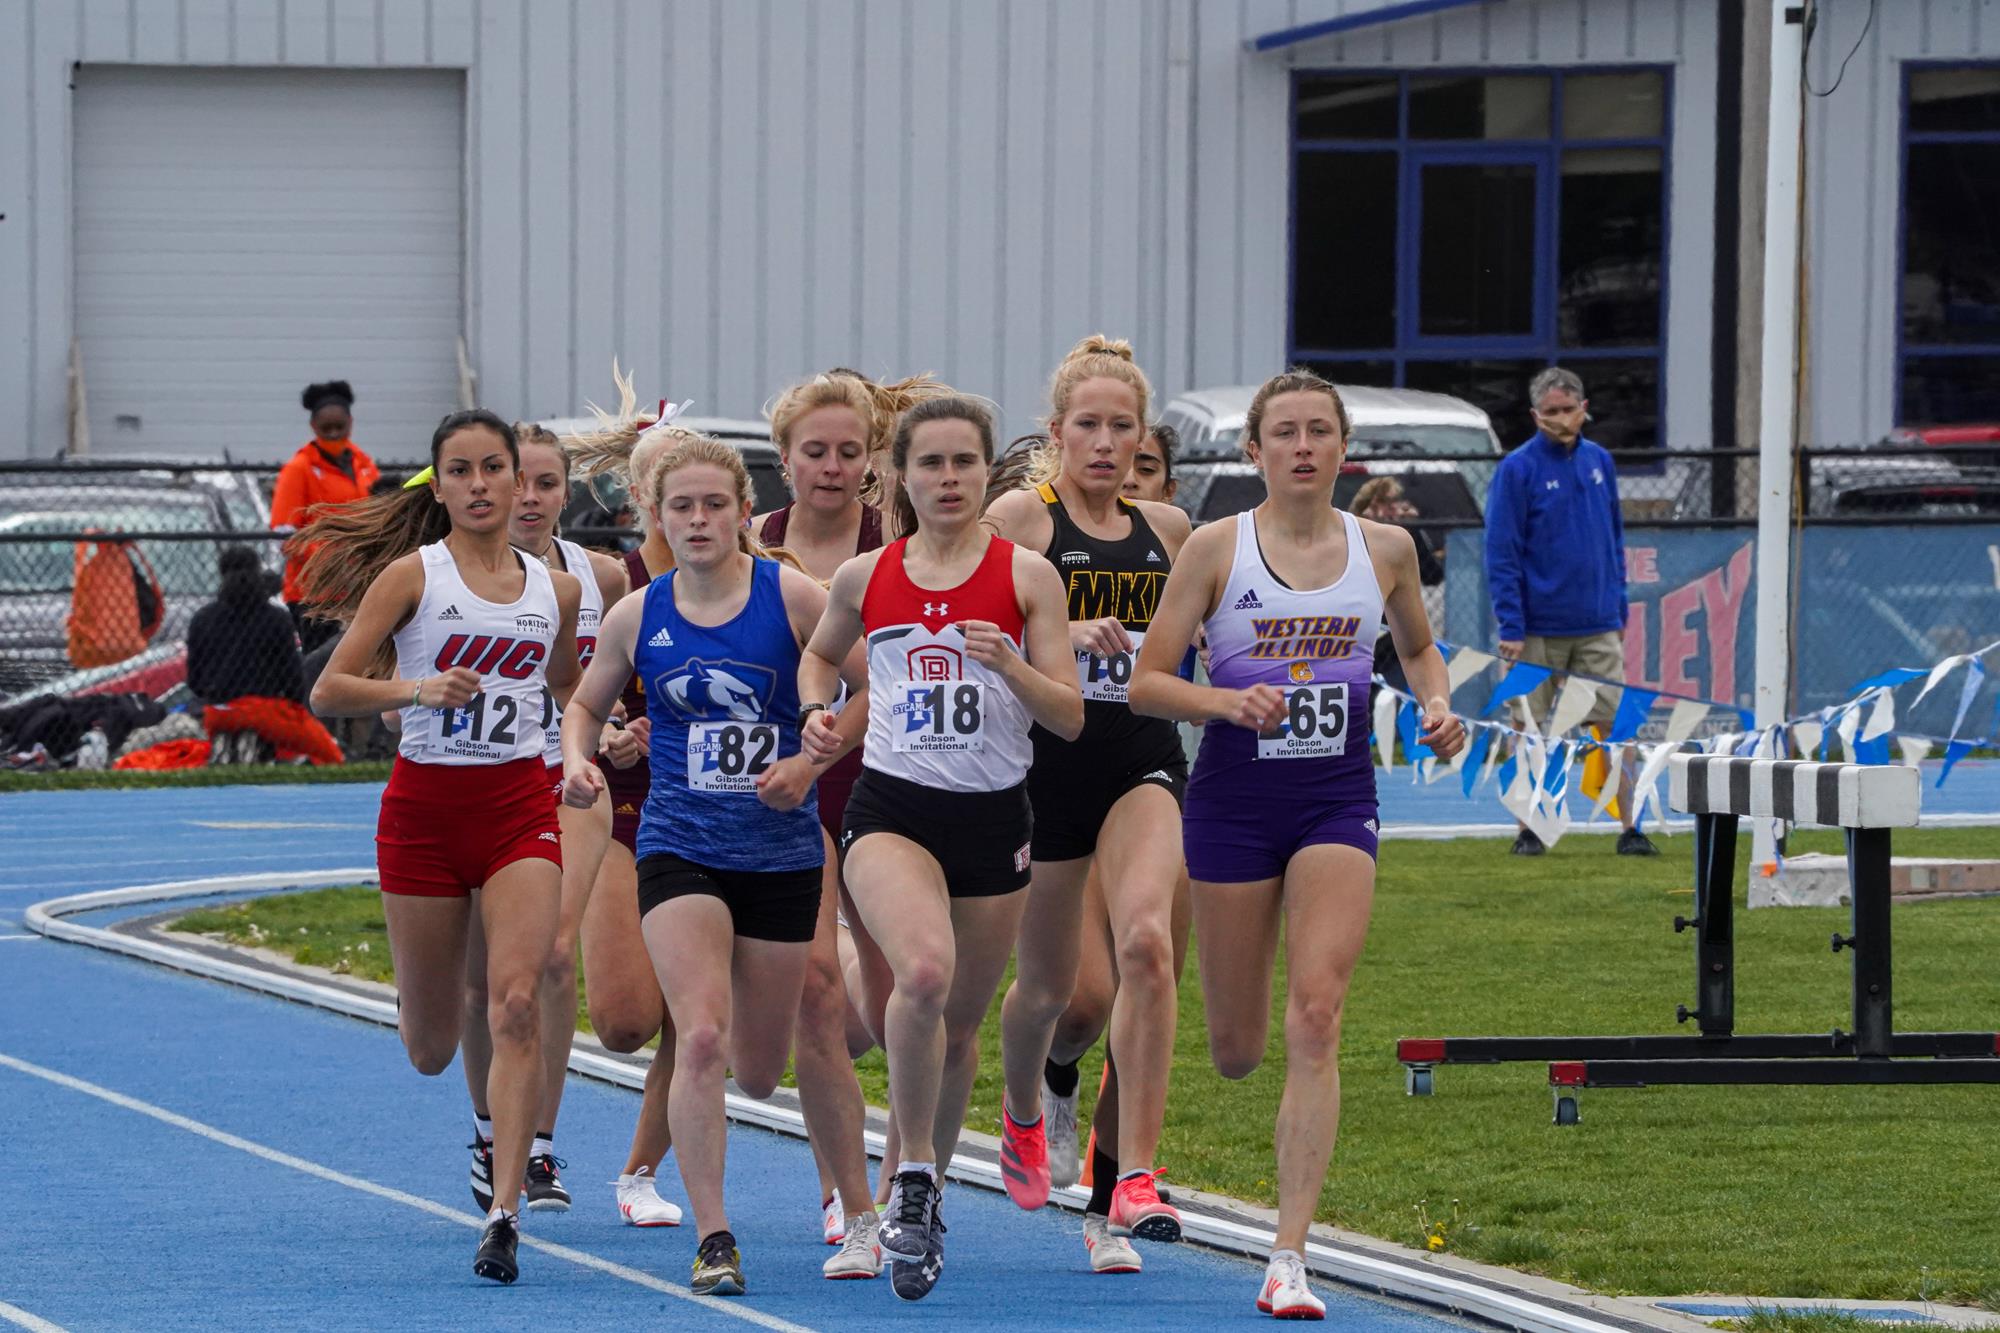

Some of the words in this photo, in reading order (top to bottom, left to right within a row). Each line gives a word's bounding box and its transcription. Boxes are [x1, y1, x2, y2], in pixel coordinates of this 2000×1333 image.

[1234, 601, 1263, 610] adidas
[516, 619, 549, 630] HORIZON
[1250, 616, 1361, 639] WESTERN
[1249, 638, 1358, 659] ILLINOIS
[434, 634, 546, 680] UIC
[1103, 684, 1128, 693] Gibs
[1092, 691, 1127, 701] Invitati
[925, 684, 981, 735] 18
[919, 735, 956, 743] Gibson
[1287, 739, 1322, 747] Gibson
[455, 739, 490, 750] Gibson
[910, 742, 968, 751] Invitational
[444, 746, 501, 759] Invitational
[718, 725, 775, 776] 82
[1277, 746, 1332, 756] Invitational
[715, 775, 750, 783] Gibson
[705, 782, 759, 791] Invitationa
